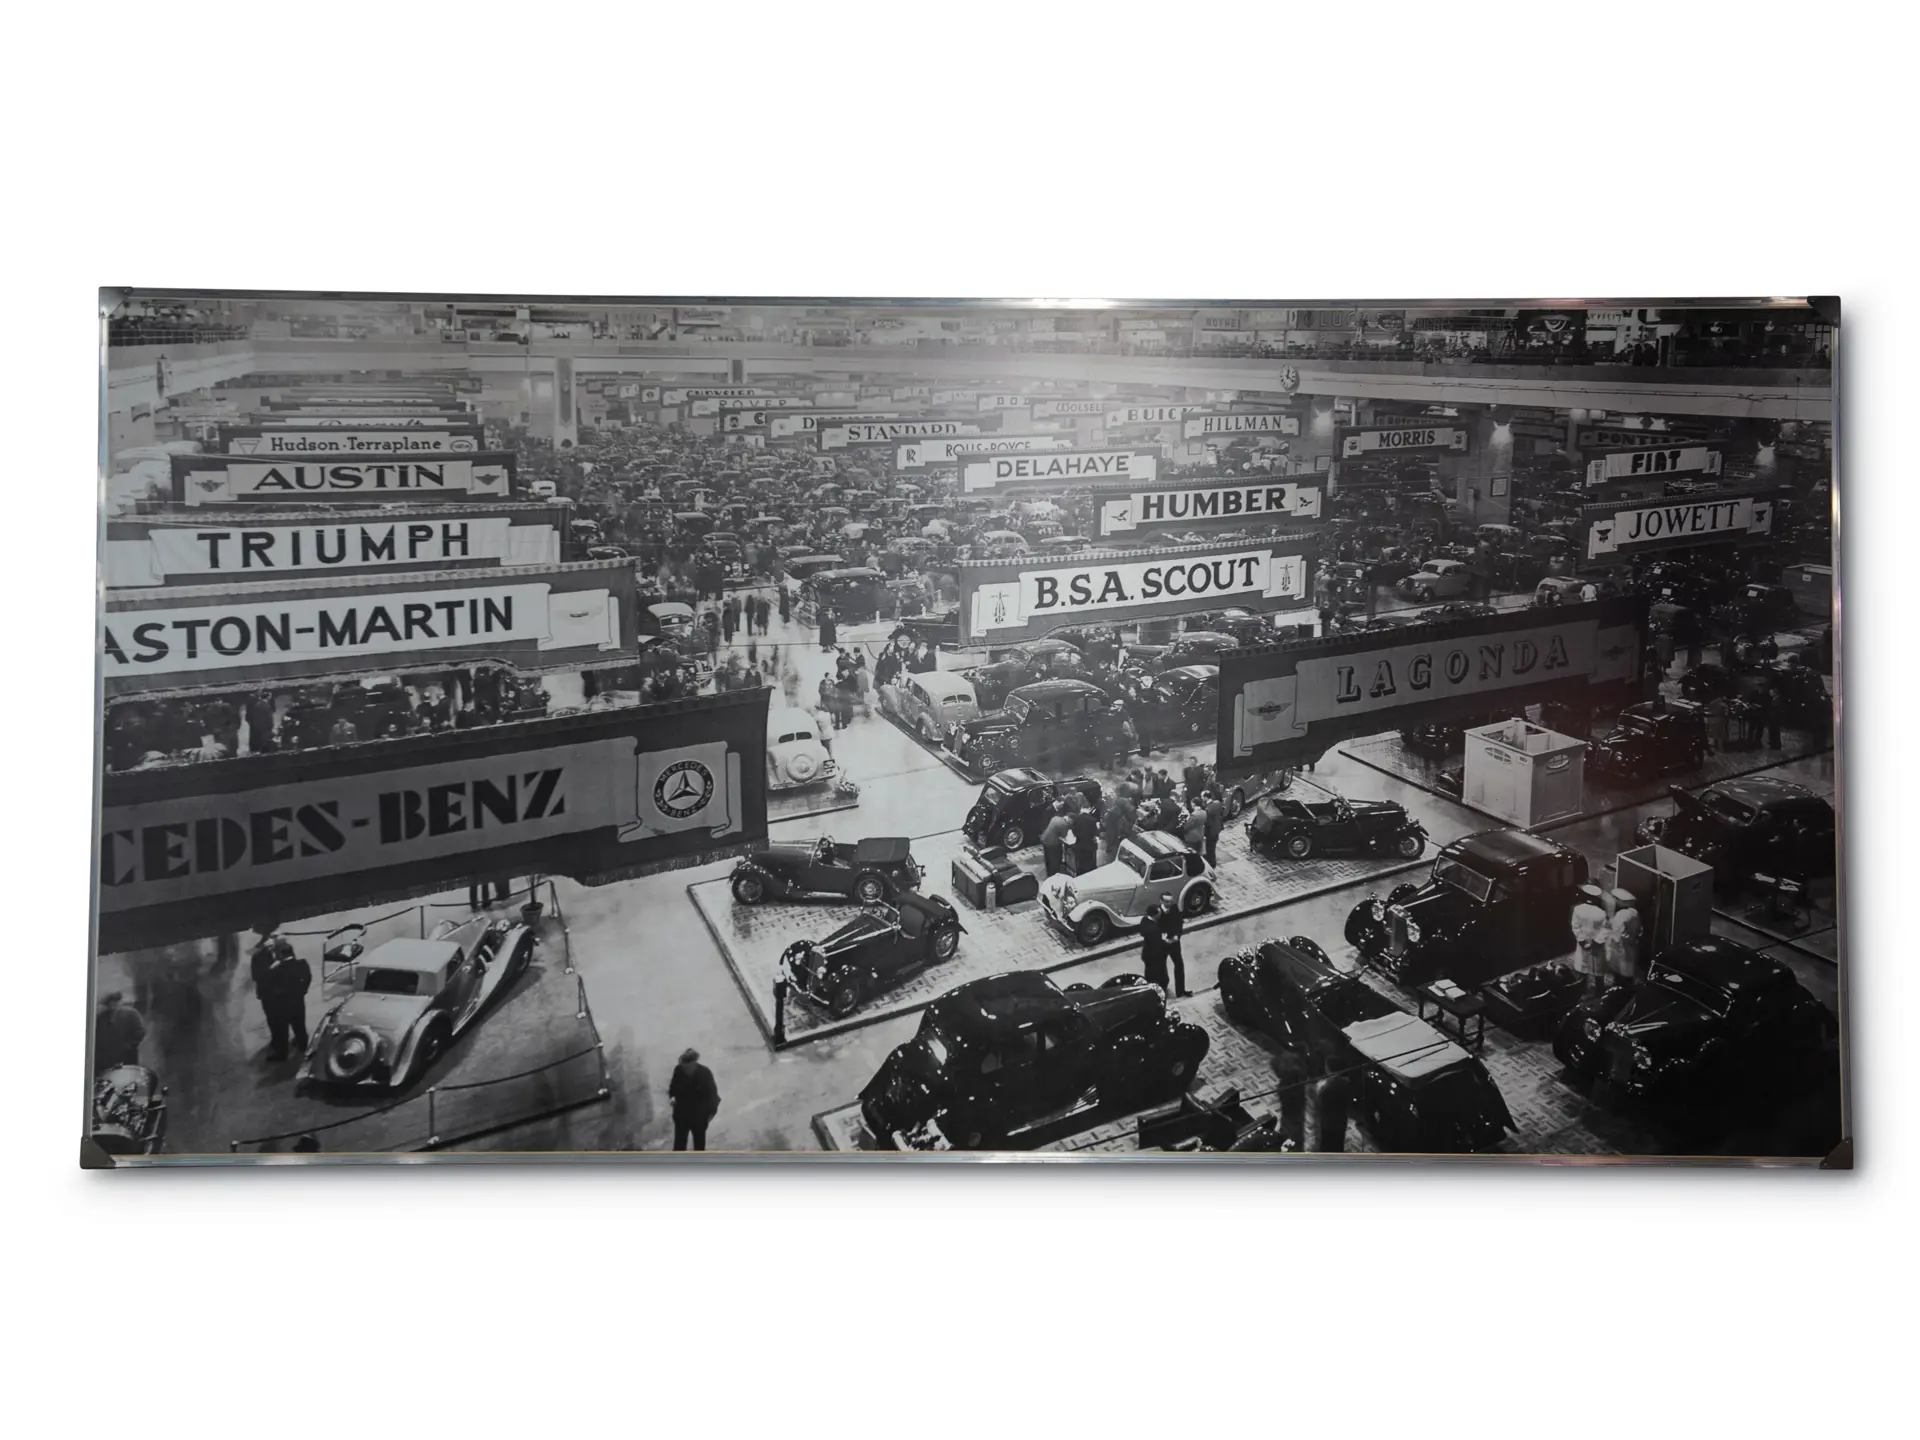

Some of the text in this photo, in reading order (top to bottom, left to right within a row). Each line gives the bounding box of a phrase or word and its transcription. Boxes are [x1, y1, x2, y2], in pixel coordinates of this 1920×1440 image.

[719, 399, 787, 408] ROVER
[848, 423, 958, 441] STANDARD
[1204, 416, 1282, 432] HILLMAN
[1378, 430, 1436, 449] MORRIS
[996, 455, 1130, 478] DELAHAYE
[1631, 450, 1682, 474] FIAT
[252, 464, 447, 491] AUSTIN
[1142, 487, 1286, 520] HUMBER
[1629, 502, 1741, 539] JOWETT
[197, 522, 469, 569] TRIUMPH
[1035, 557, 1260, 609] B.S.A. SCOUT
[1337, 635, 1568, 704] LAGONDA
